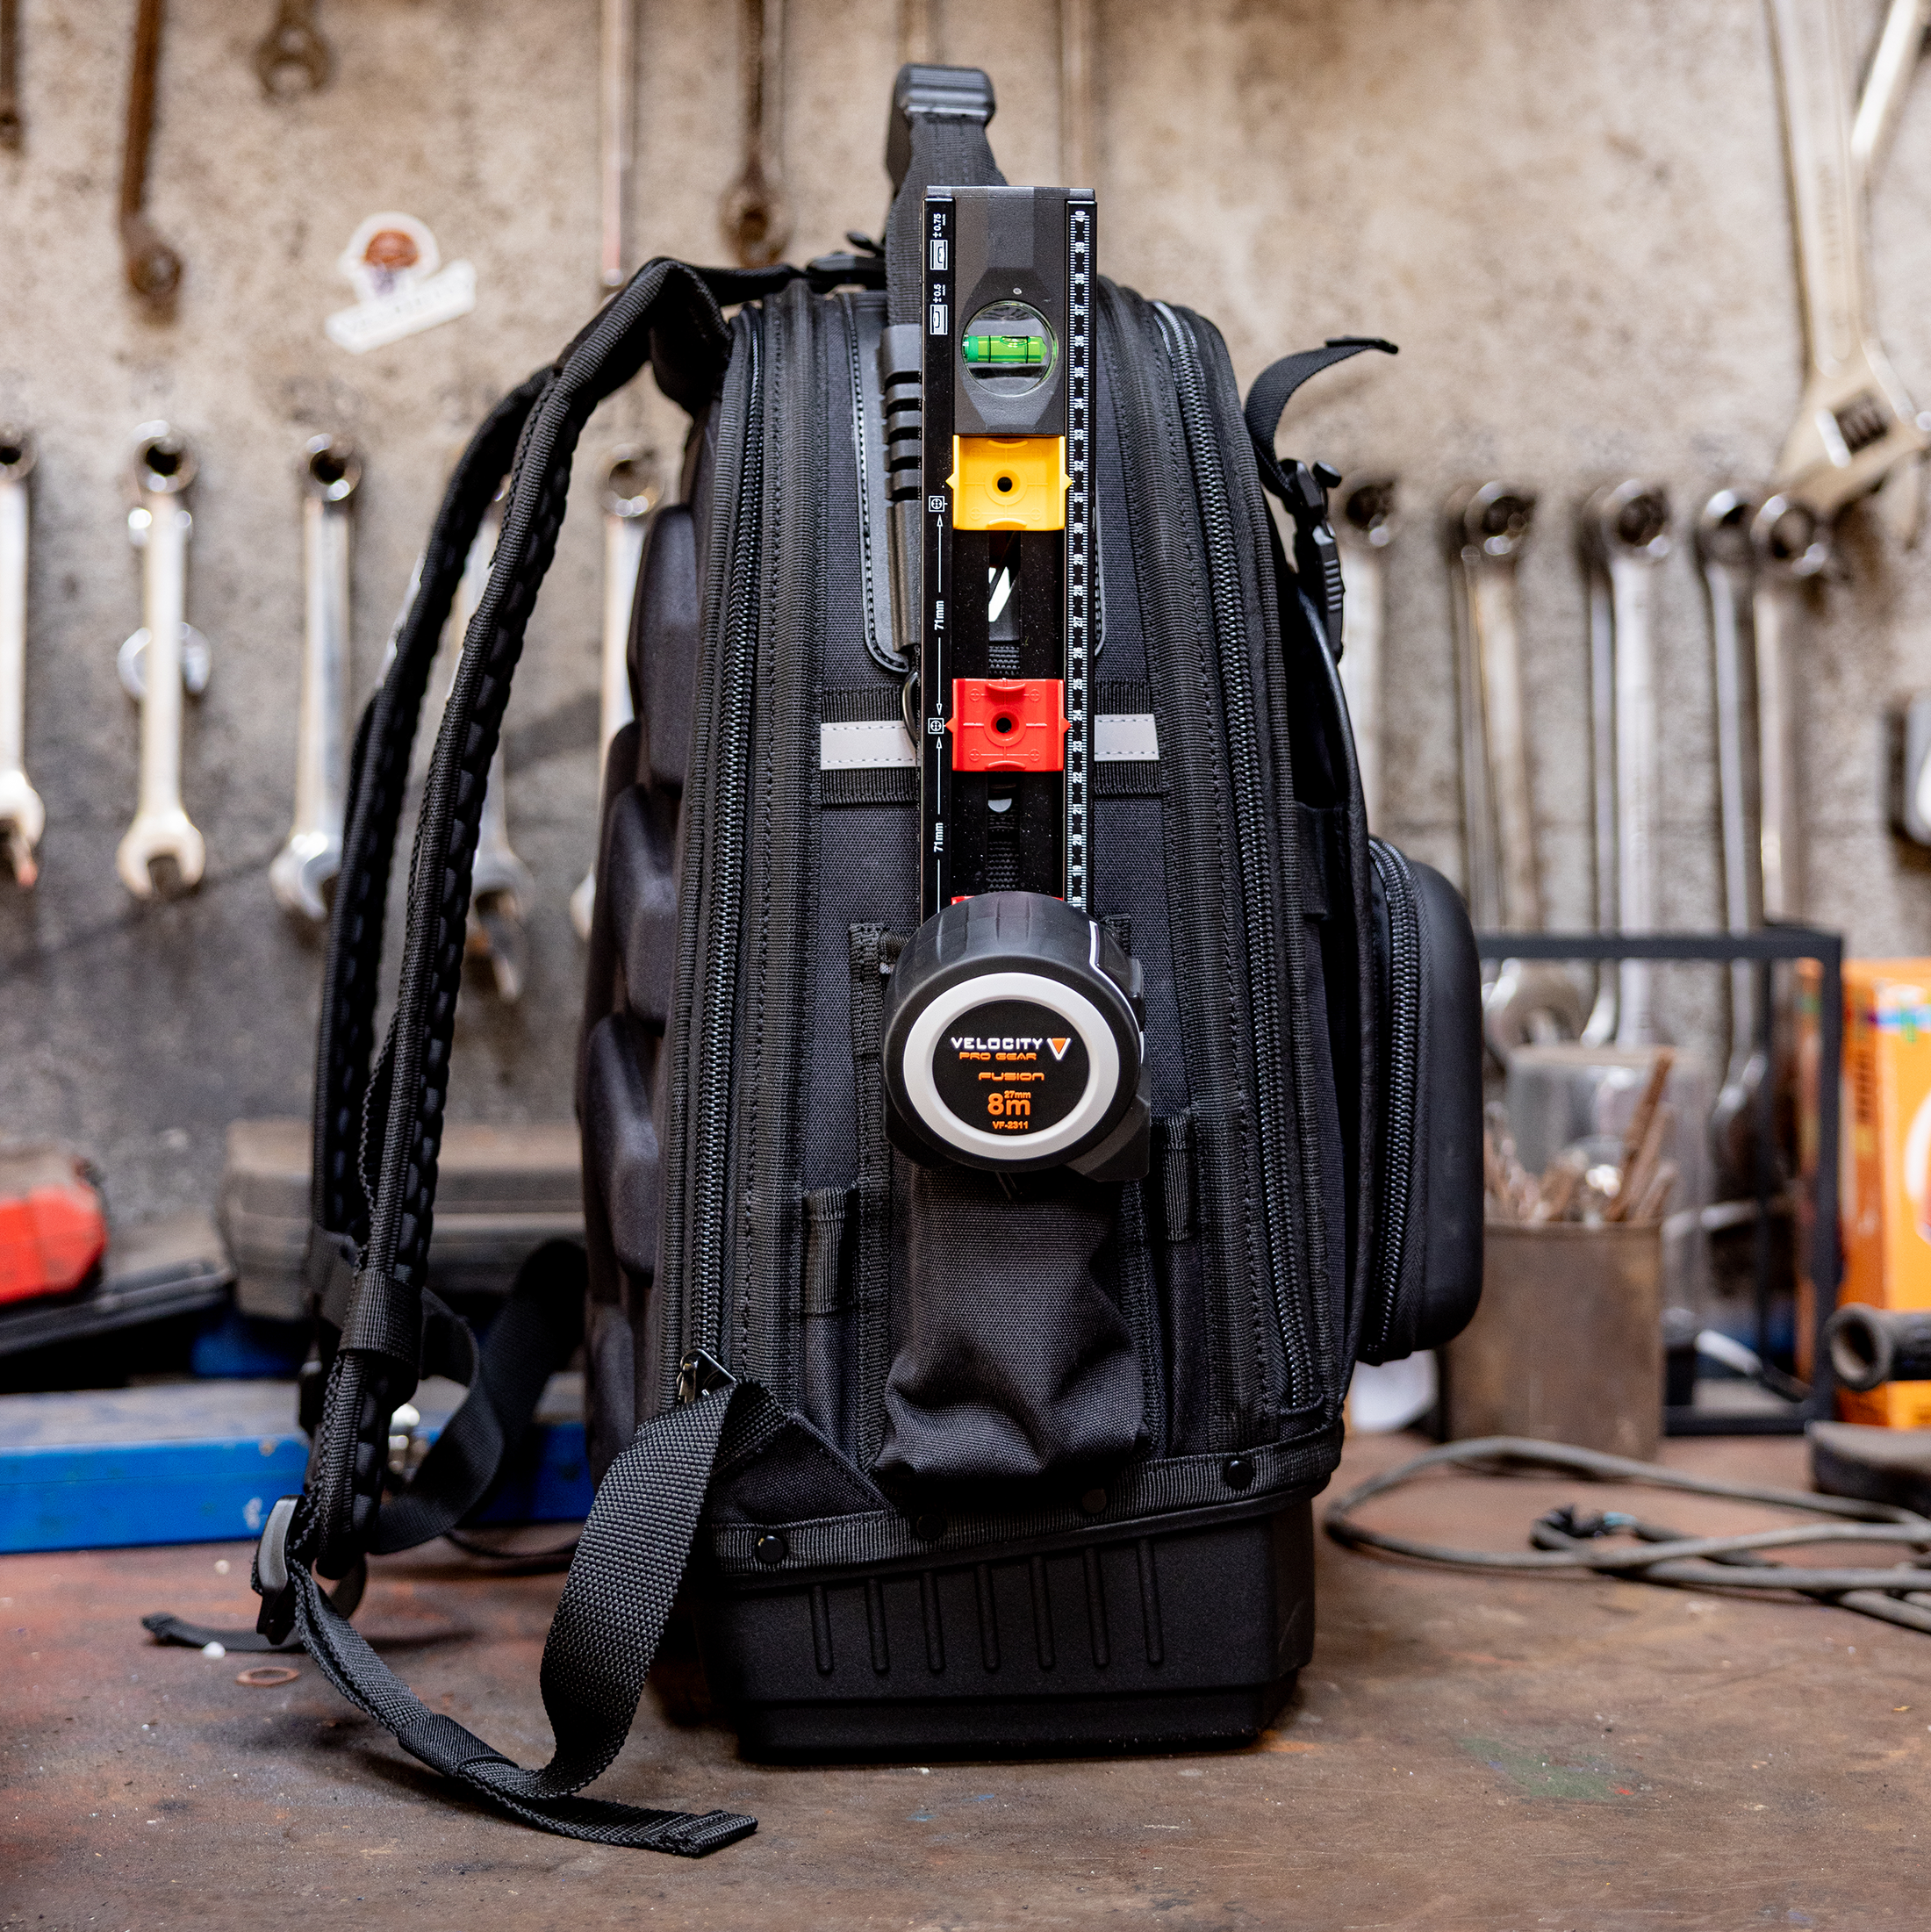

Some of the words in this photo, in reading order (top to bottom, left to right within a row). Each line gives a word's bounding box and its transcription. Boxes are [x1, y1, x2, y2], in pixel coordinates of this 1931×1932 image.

[1074, 211, 1085, 222] 40
[932, 213, 942, 238] ±0.75
[1074, 242, 1085, 253] 39
[1074, 273, 1085, 284] 38
[932, 284, 942, 303] ±0.5
[1074, 305, 1085, 315] 37
[1074, 335, 1085, 347] 36
[1074, 367, 1085, 378] 35
[1073, 398, 1084, 409] 34
[1073, 429, 1084, 440] 33
[1073, 460, 1084, 471] 32
[1073, 492, 1084, 502] 31
[1073, 523, 1084, 534] 30
[1073, 554, 1083, 565] 29
[1073, 585, 1083, 596] 28
[934, 600, 944, 630] 71mm
[1073, 616, 1083, 628] 27
[1073, 647, 1083, 658] 26
[1073, 679, 1083, 690] 25
[1073, 709, 1083, 721] 24
[1073, 741, 1082, 752] 23
[1073, 772, 1082, 783] 22
[1073, 803, 1082, 815] 21
[934, 822, 944, 852] 71mm
[1073, 834, 1082, 845] 20
[1073, 865, 1082, 876] 19
[1073, 896, 1082, 907] 18
[951, 1037, 1043, 1050] VELOCITY
[958, 1052, 991, 1060] PRO
[1004, 1090, 1031, 1099] 27mm
[987, 1092, 1030, 1116] 8m
[992, 1120, 1029, 1130] VF-2311
